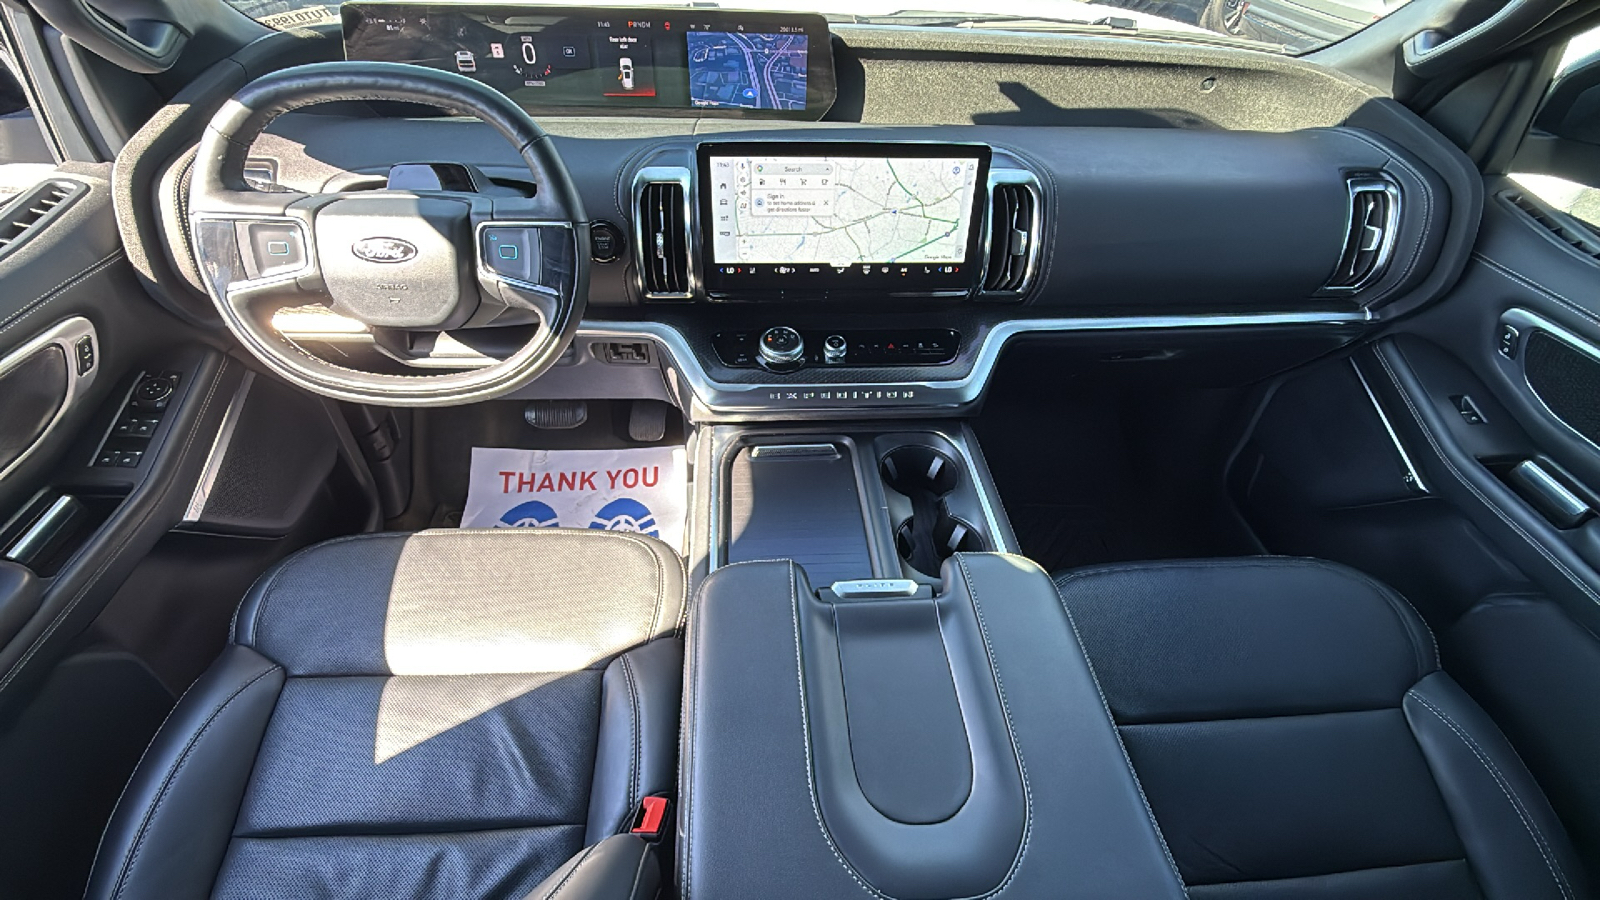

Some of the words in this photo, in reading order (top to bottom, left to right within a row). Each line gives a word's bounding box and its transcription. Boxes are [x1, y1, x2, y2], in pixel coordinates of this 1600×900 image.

[521, 42, 537, 65] 0
[357, 240, 406, 258] Ford
[769, 390, 915, 400] EXPEDITION
[498, 471, 598, 494] THANK
[606, 466, 660, 490] YOU
